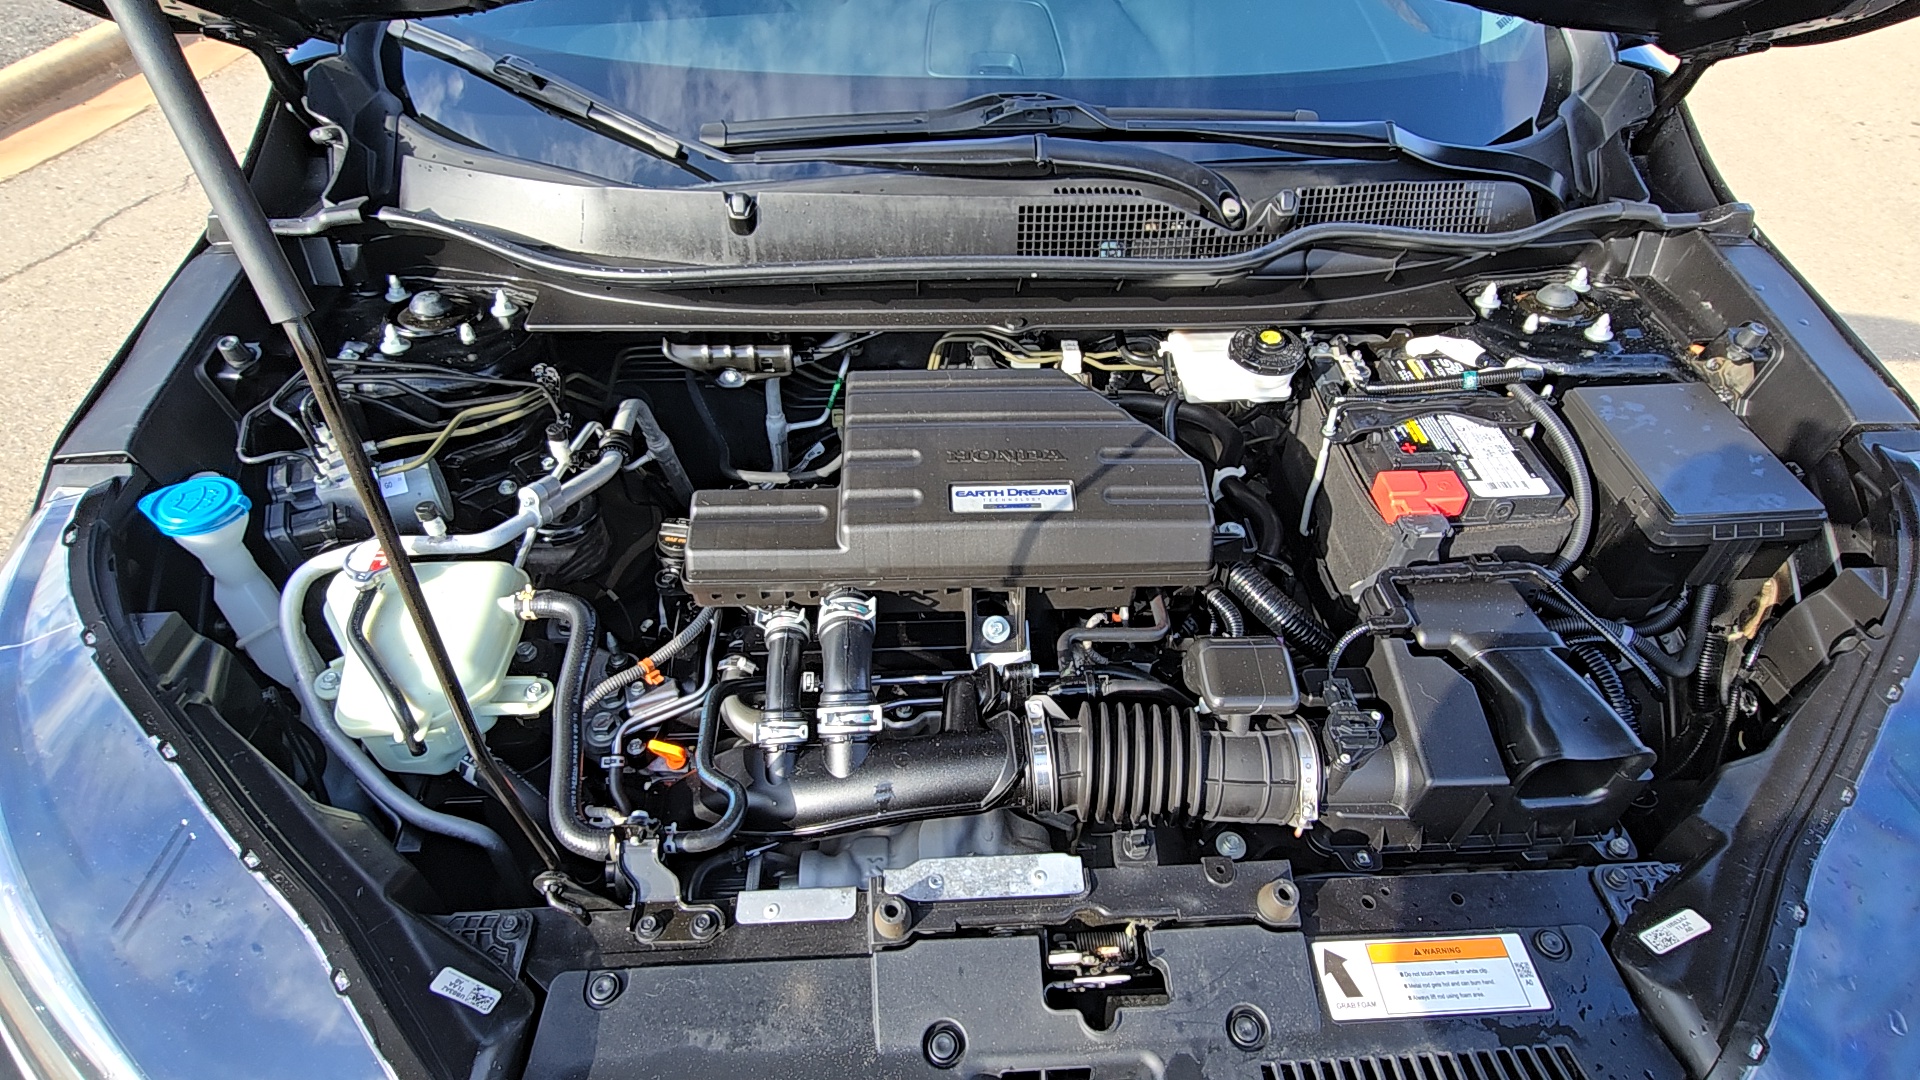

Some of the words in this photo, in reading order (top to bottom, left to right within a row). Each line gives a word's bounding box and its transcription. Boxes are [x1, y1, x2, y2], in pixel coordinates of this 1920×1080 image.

[946, 449, 1068, 464] HONDA
[955, 490, 1004, 498] EARTH
[1007, 488, 1067, 497] DREAMS
[1422, 947, 1461, 955] WARNING
